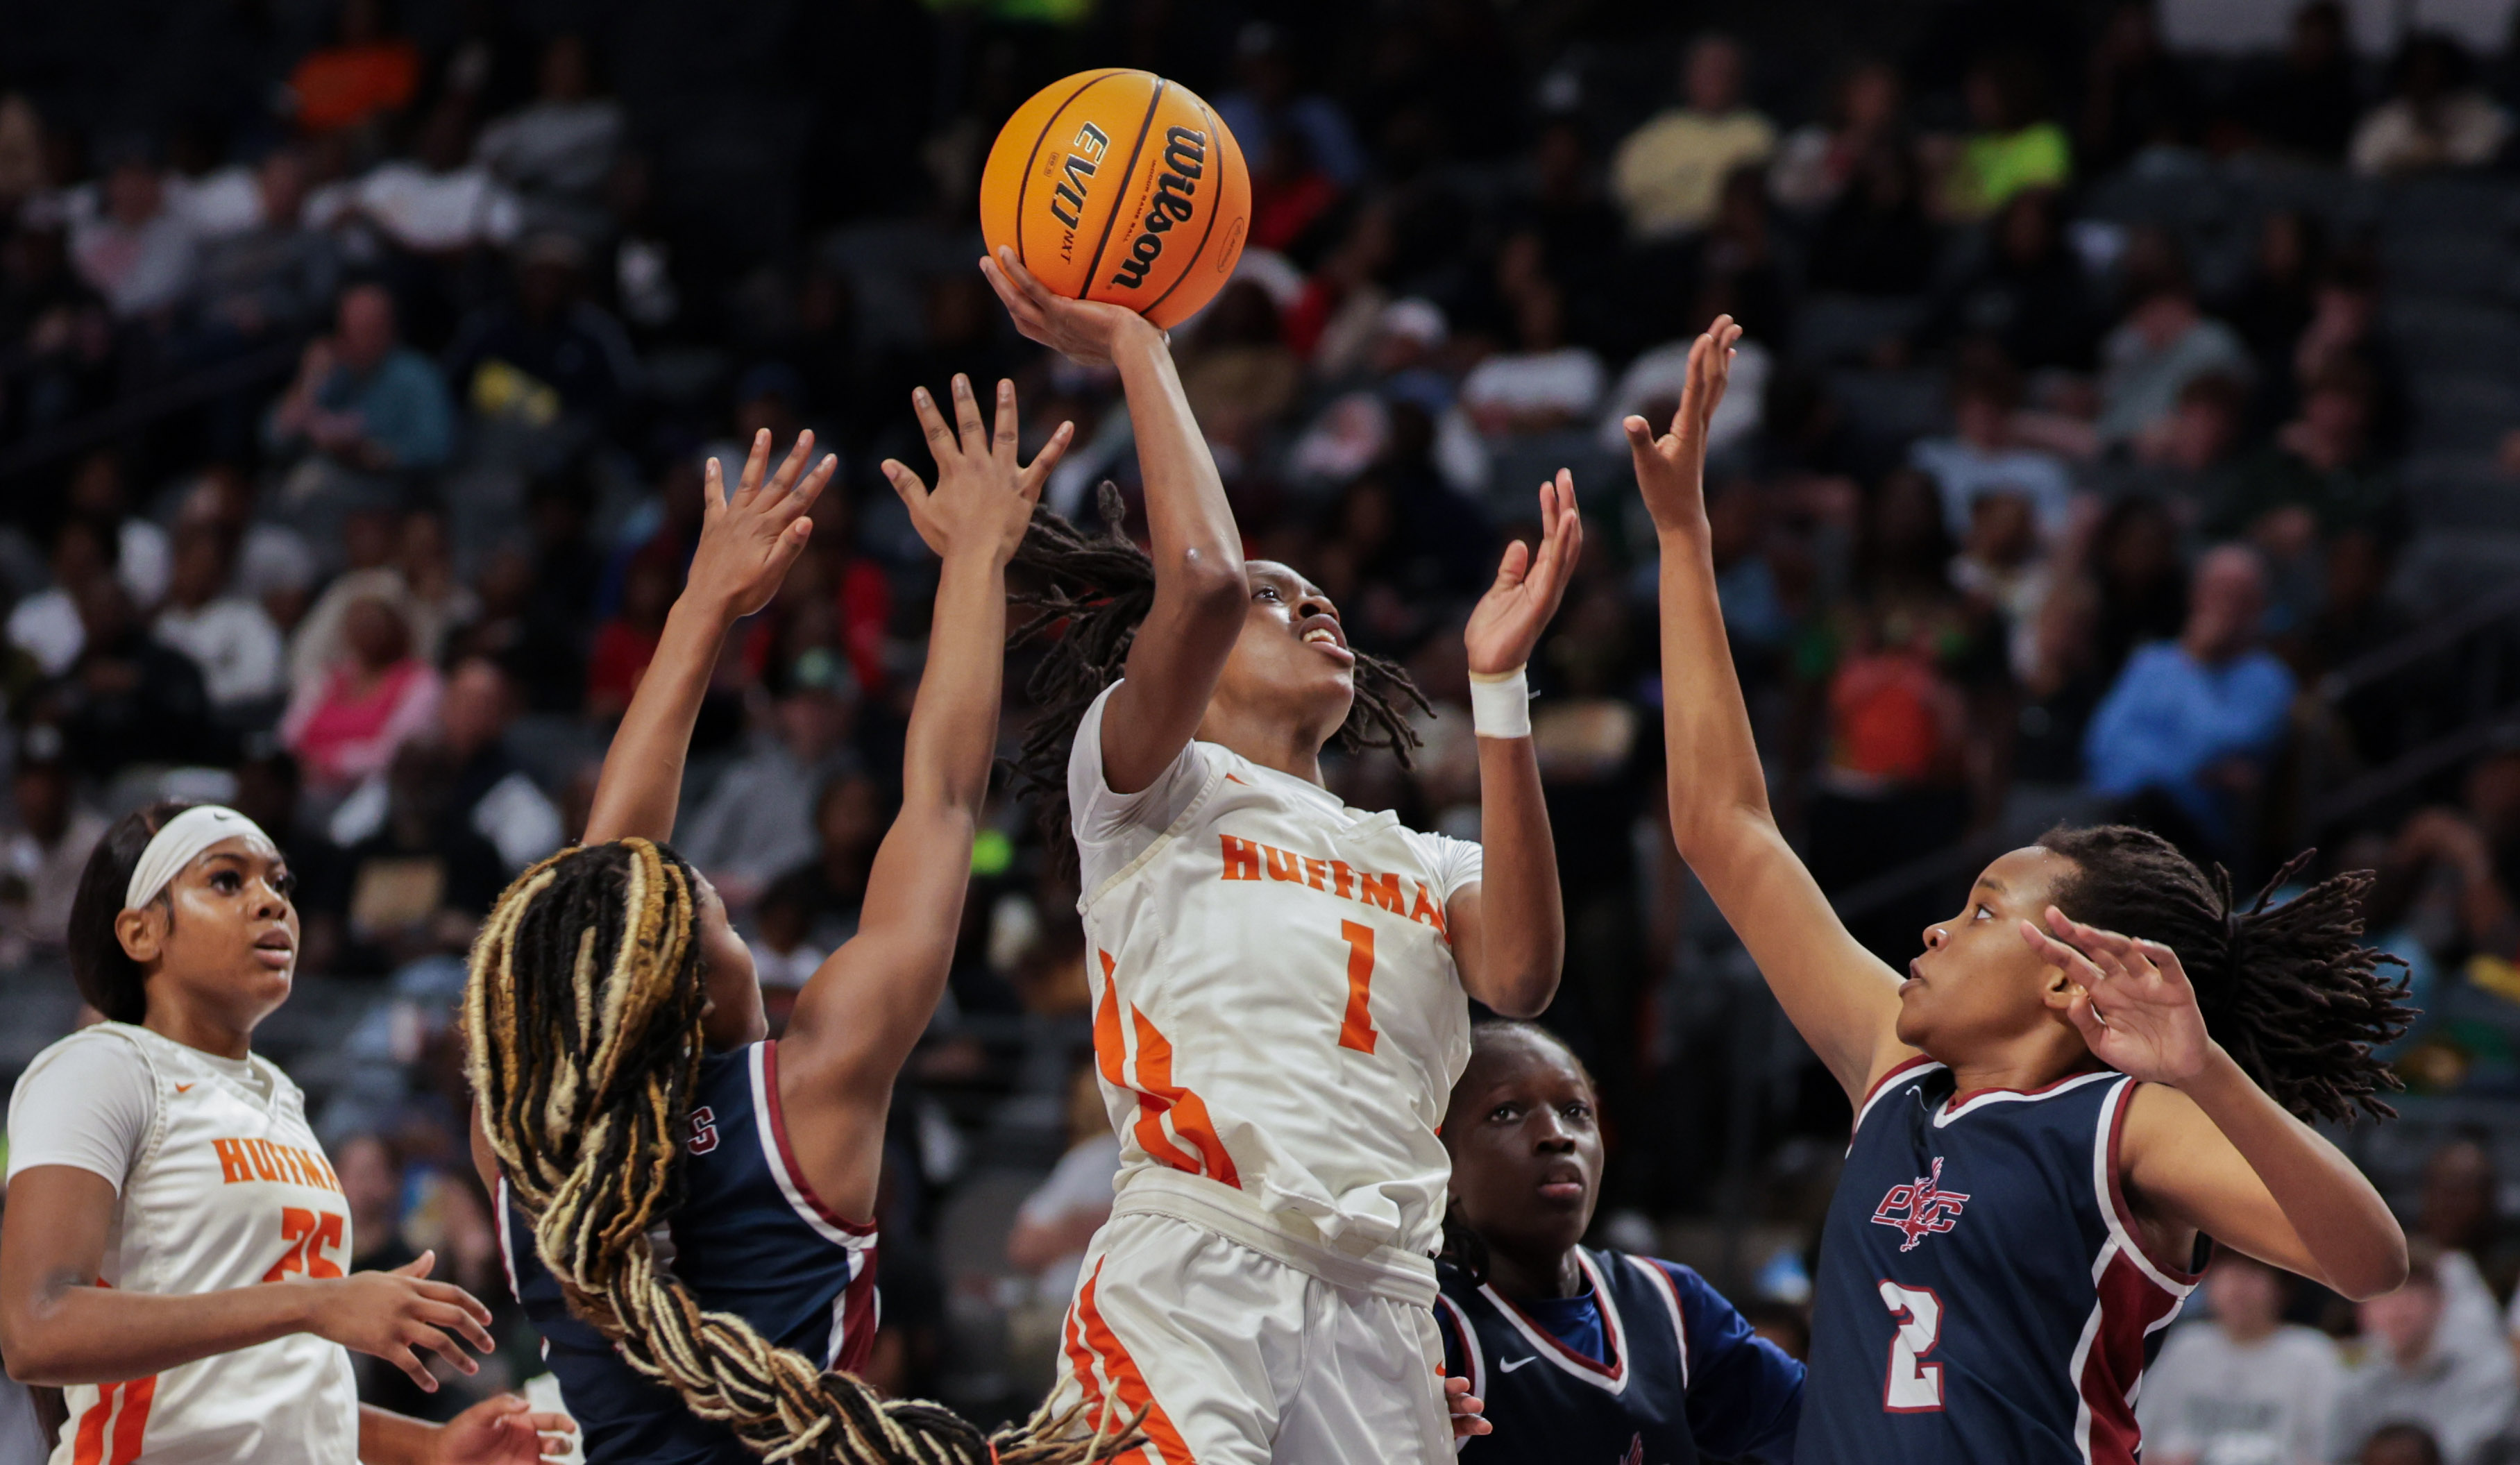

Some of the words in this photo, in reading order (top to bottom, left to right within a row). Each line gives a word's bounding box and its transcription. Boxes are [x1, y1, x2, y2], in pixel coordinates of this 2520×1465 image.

[1051, 121, 1110, 230] EVO
[1111, 126, 1206, 289] Wilson
[1134, 195, 1147, 219] GAME
[1145, 159, 1157, 193] INDOOR
[1060, 230, 1074, 265] NXT
[1123, 222, 1137, 243] BALL
[1219, 833, 1452, 945] HUFFMA
[1338, 918, 1378, 1056] 1
[1878, 1278, 1946, 1414] 2
